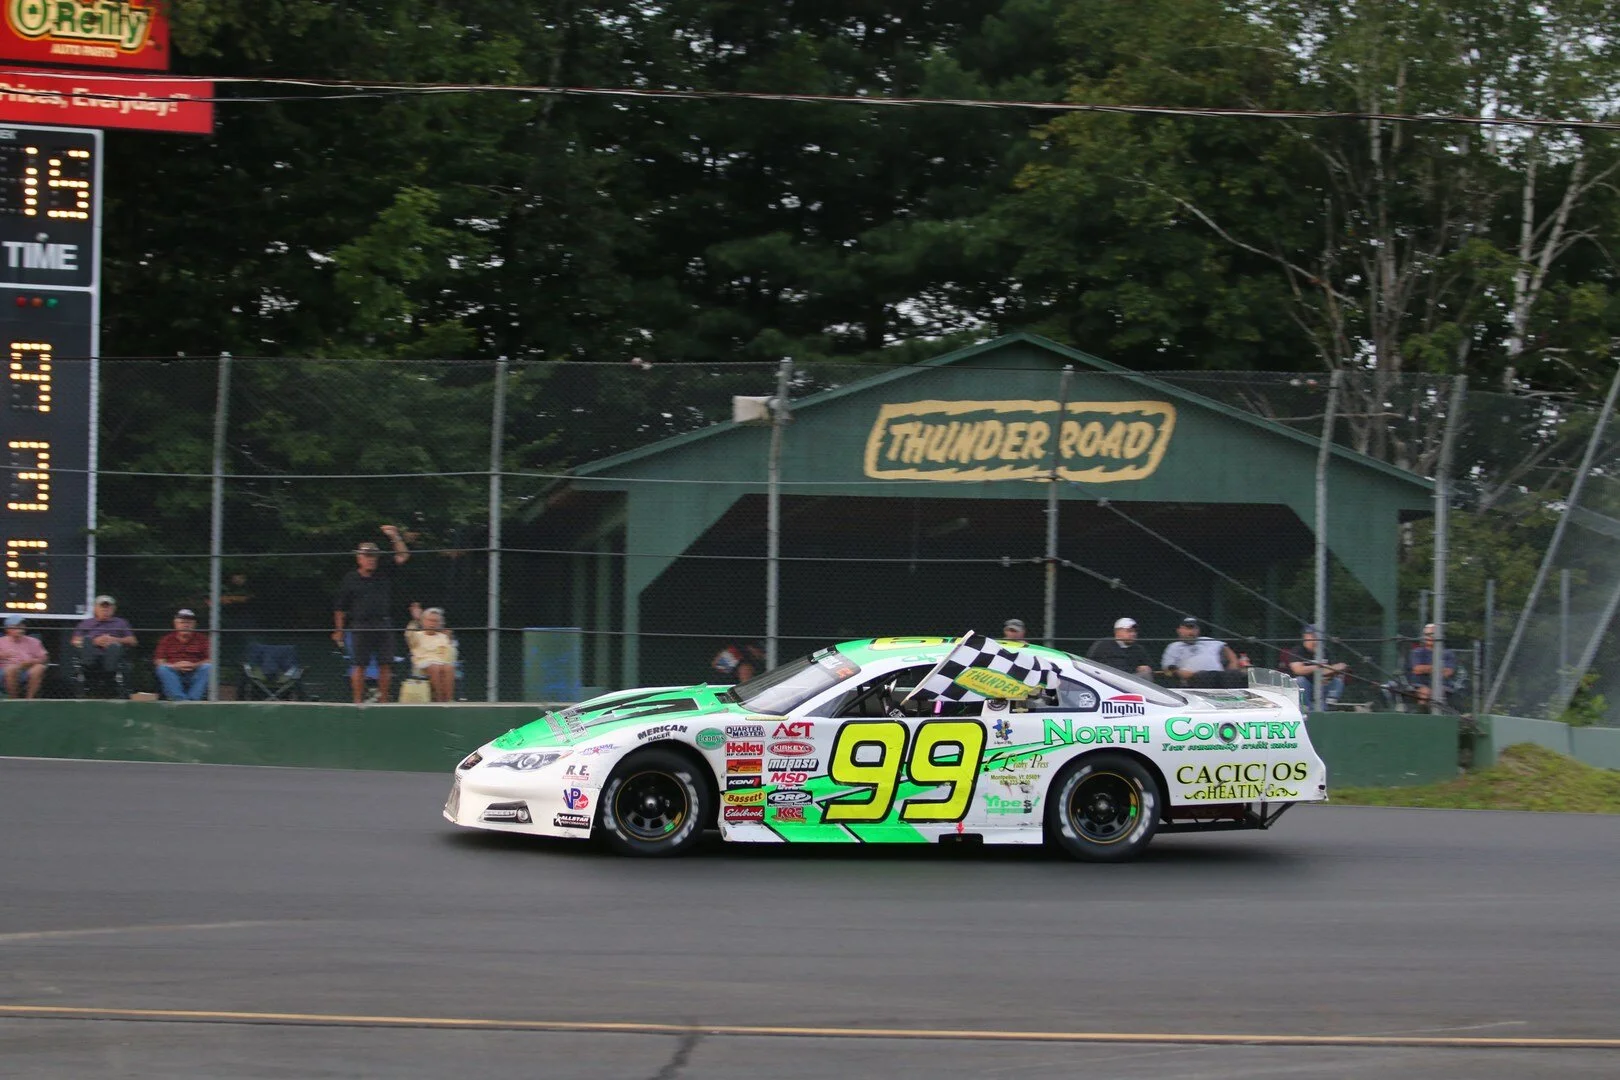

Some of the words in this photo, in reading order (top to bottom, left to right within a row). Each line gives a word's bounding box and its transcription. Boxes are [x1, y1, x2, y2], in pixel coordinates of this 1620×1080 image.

[2, 241, 78, 270] TIME
[10, 342, 52, 412] 9
[886, 420, 1050, 464] THUNDER
[1059, 420, 1155, 460] ROAD
[7, 441, 50, 511] 3
[6, 540, 48, 610] 5
[967, 670, 1020, 694] THUNDER
[1102, 701, 1145, 716] Mighty
[726, 726, 762, 734] QUARTER
[772, 722, 815, 737] ACT
[1043, 718, 1150, 745] NORTH
[726, 743, 763, 756] Holley
[1162, 743, 1185, 752] Your
[770, 773, 808, 783] MSD
[820, 719, 988, 824] 99
[563, 788, 582, 810] VP
[727, 792, 762, 803] Bassett
[725, 808, 763, 817] Edelbrock
